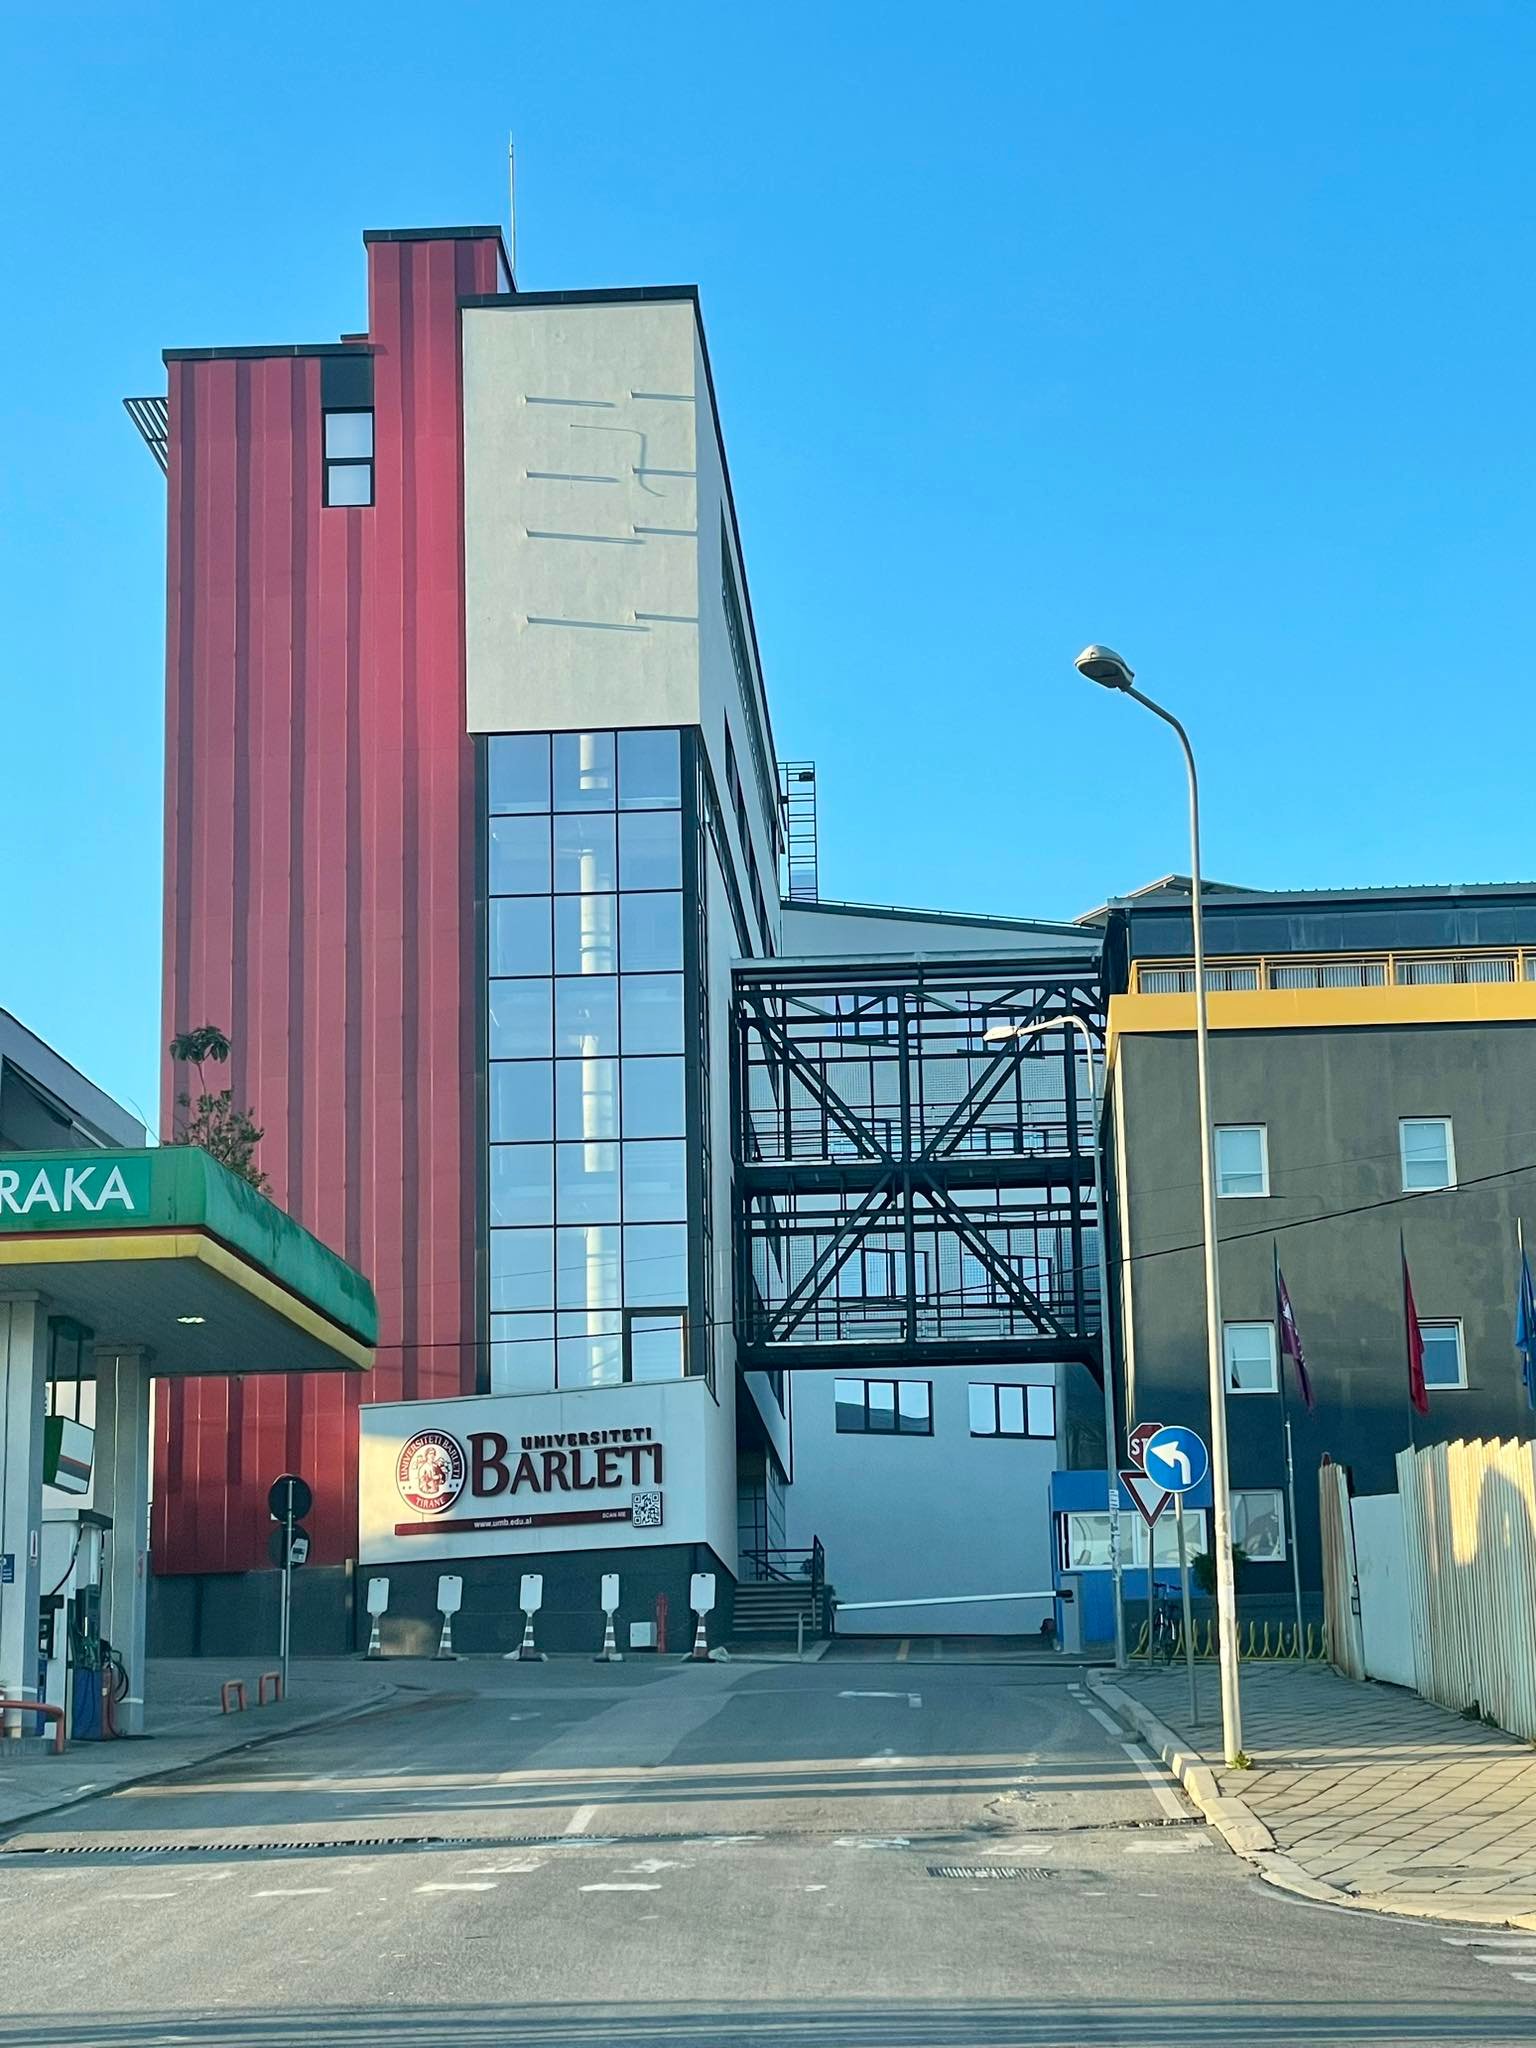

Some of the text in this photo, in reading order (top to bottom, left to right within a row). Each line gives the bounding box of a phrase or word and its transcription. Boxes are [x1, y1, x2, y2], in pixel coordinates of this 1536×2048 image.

[0, 1165, 135, 1214] RAKA
[521, 1427, 652, 1449] UNIVERSITETI
[1131, 1438, 1150, 1455] ST
[400, 1435, 441, 1479] UNIVERSITETI
[474, 1517, 532, 1528] www.umb.edu.al
